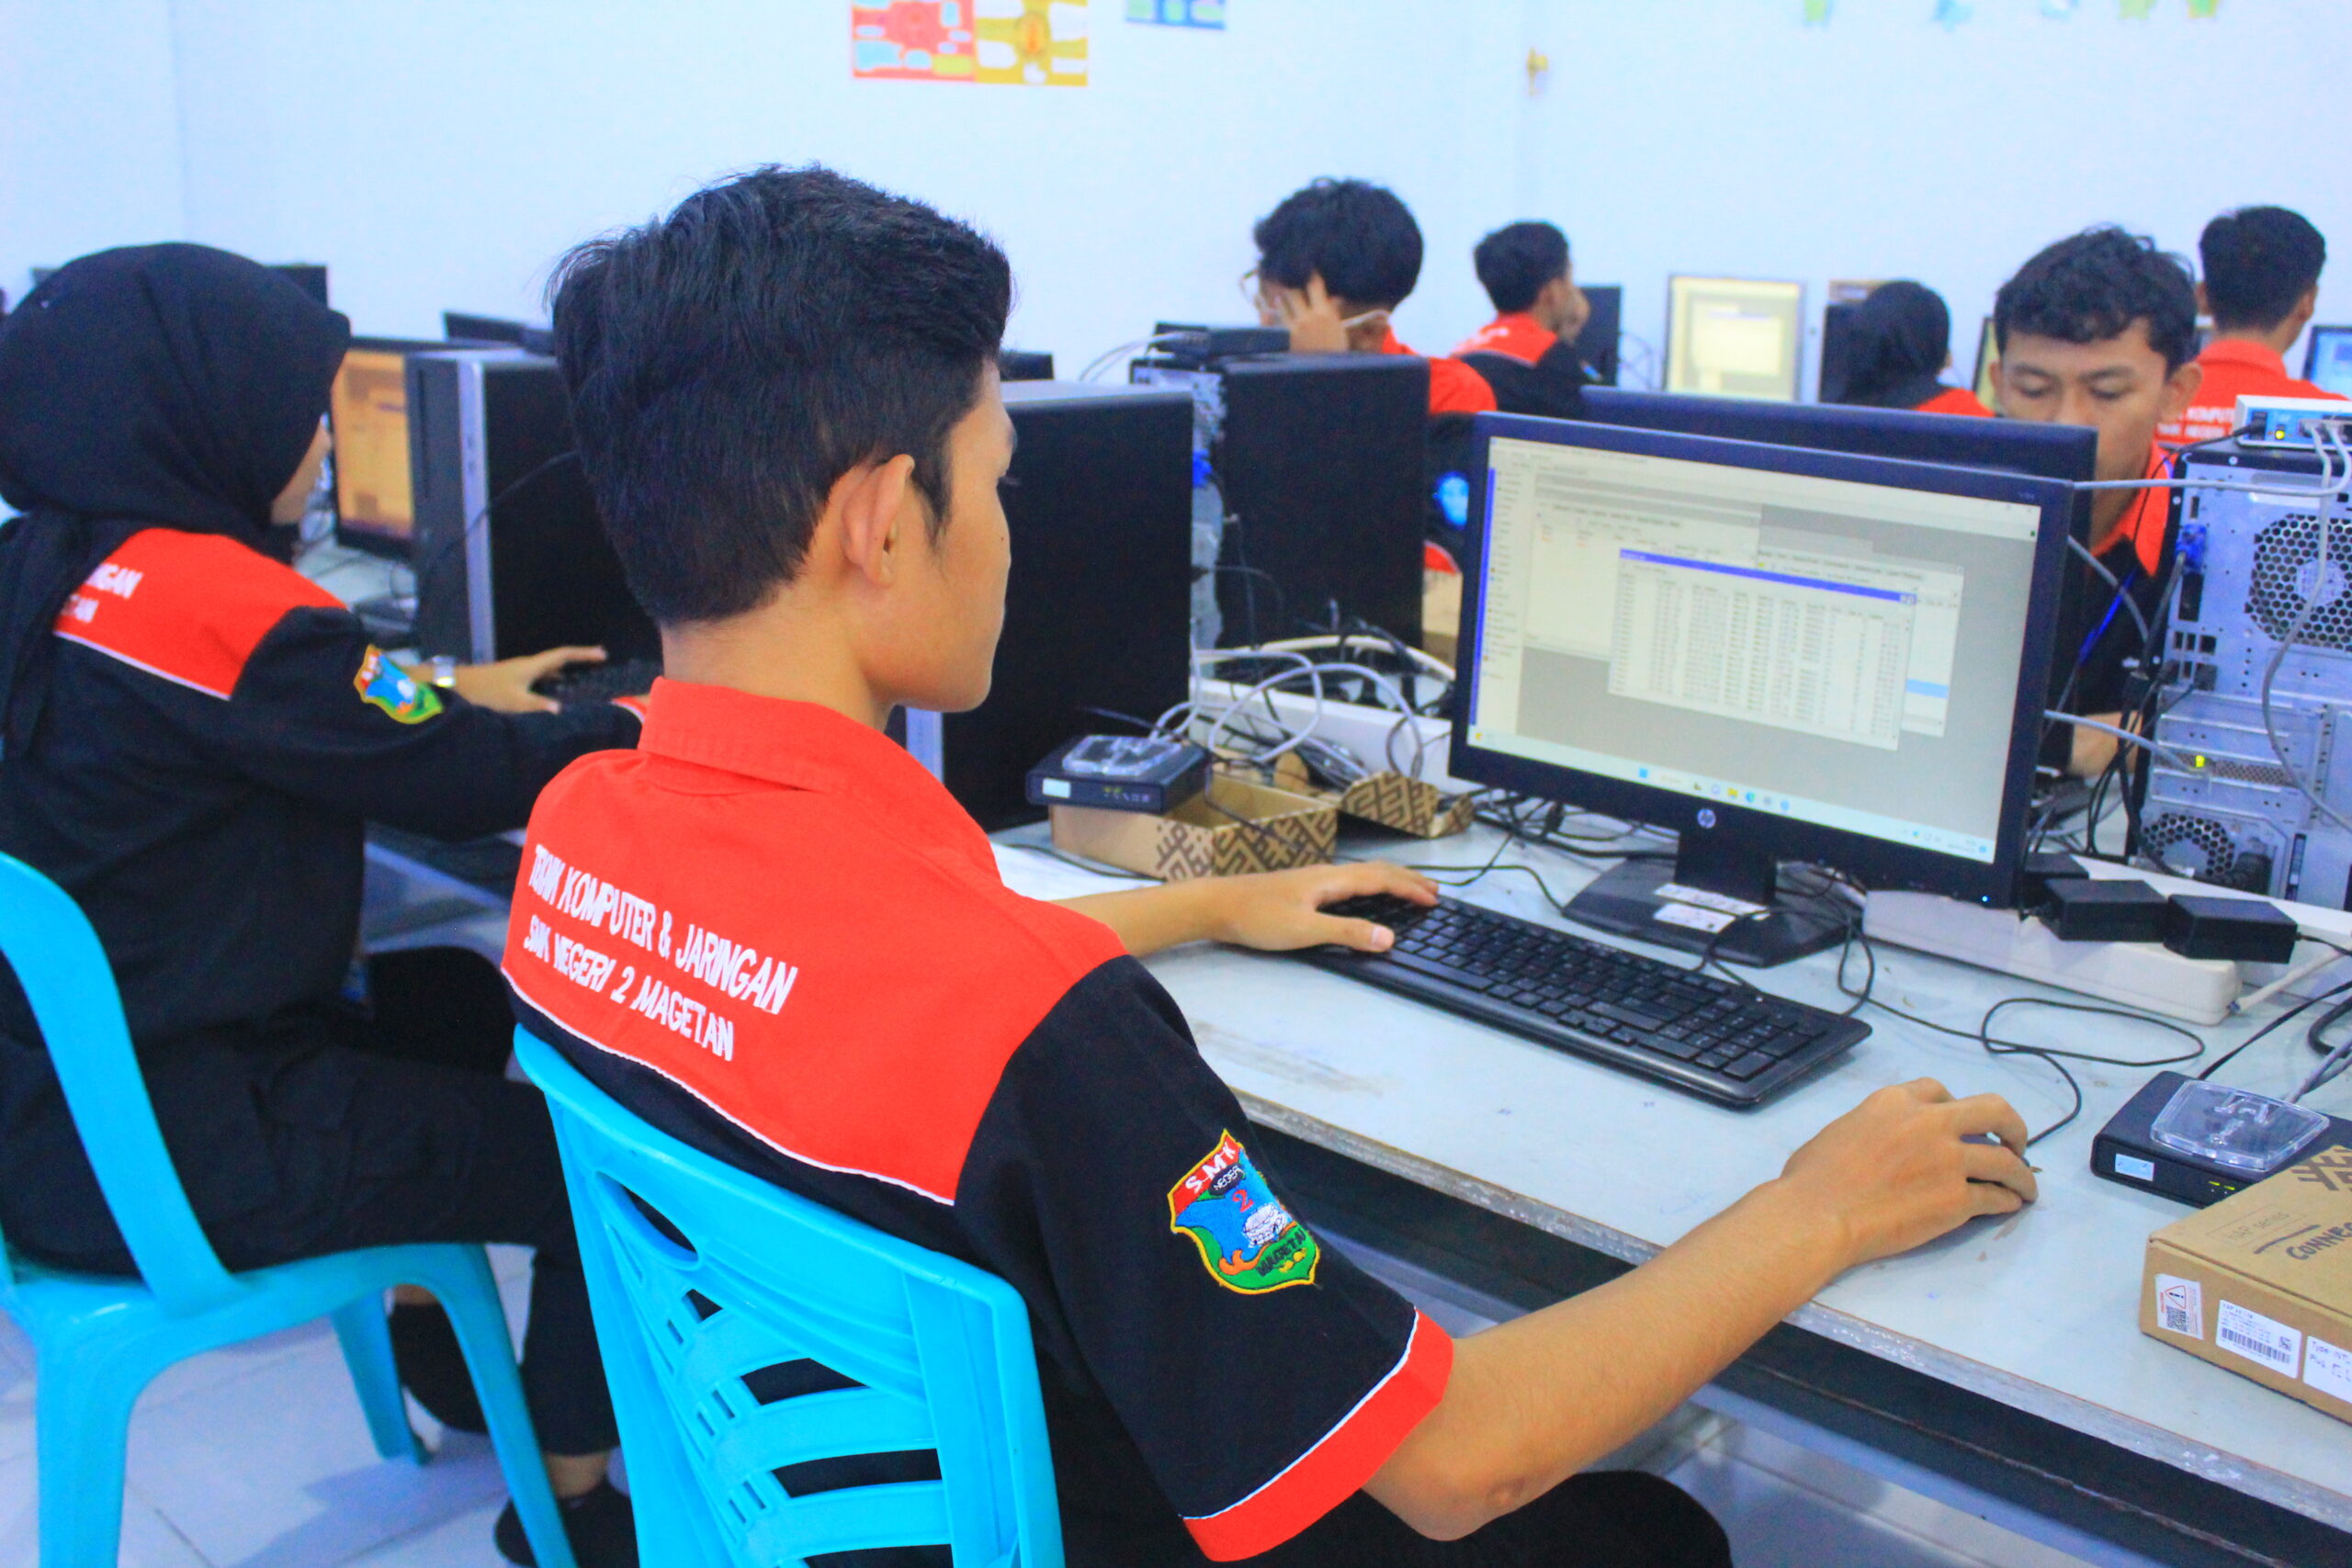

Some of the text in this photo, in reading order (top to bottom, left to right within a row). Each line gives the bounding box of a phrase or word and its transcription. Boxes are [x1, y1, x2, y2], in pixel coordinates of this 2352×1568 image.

[556, 866, 656, 952] KOMPUTER
[658, 910, 673, 960] &
[675, 923, 798, 1015] JARINGAN
[553, 932, 616, 993] NEGERI
[610, 965, 636, 1004] 2
[629, 976, 734, 1062] MAGETAN
[1185, 1141, 1237, 1194] SMK
[1232, 1189, 1254, 1213] 2
